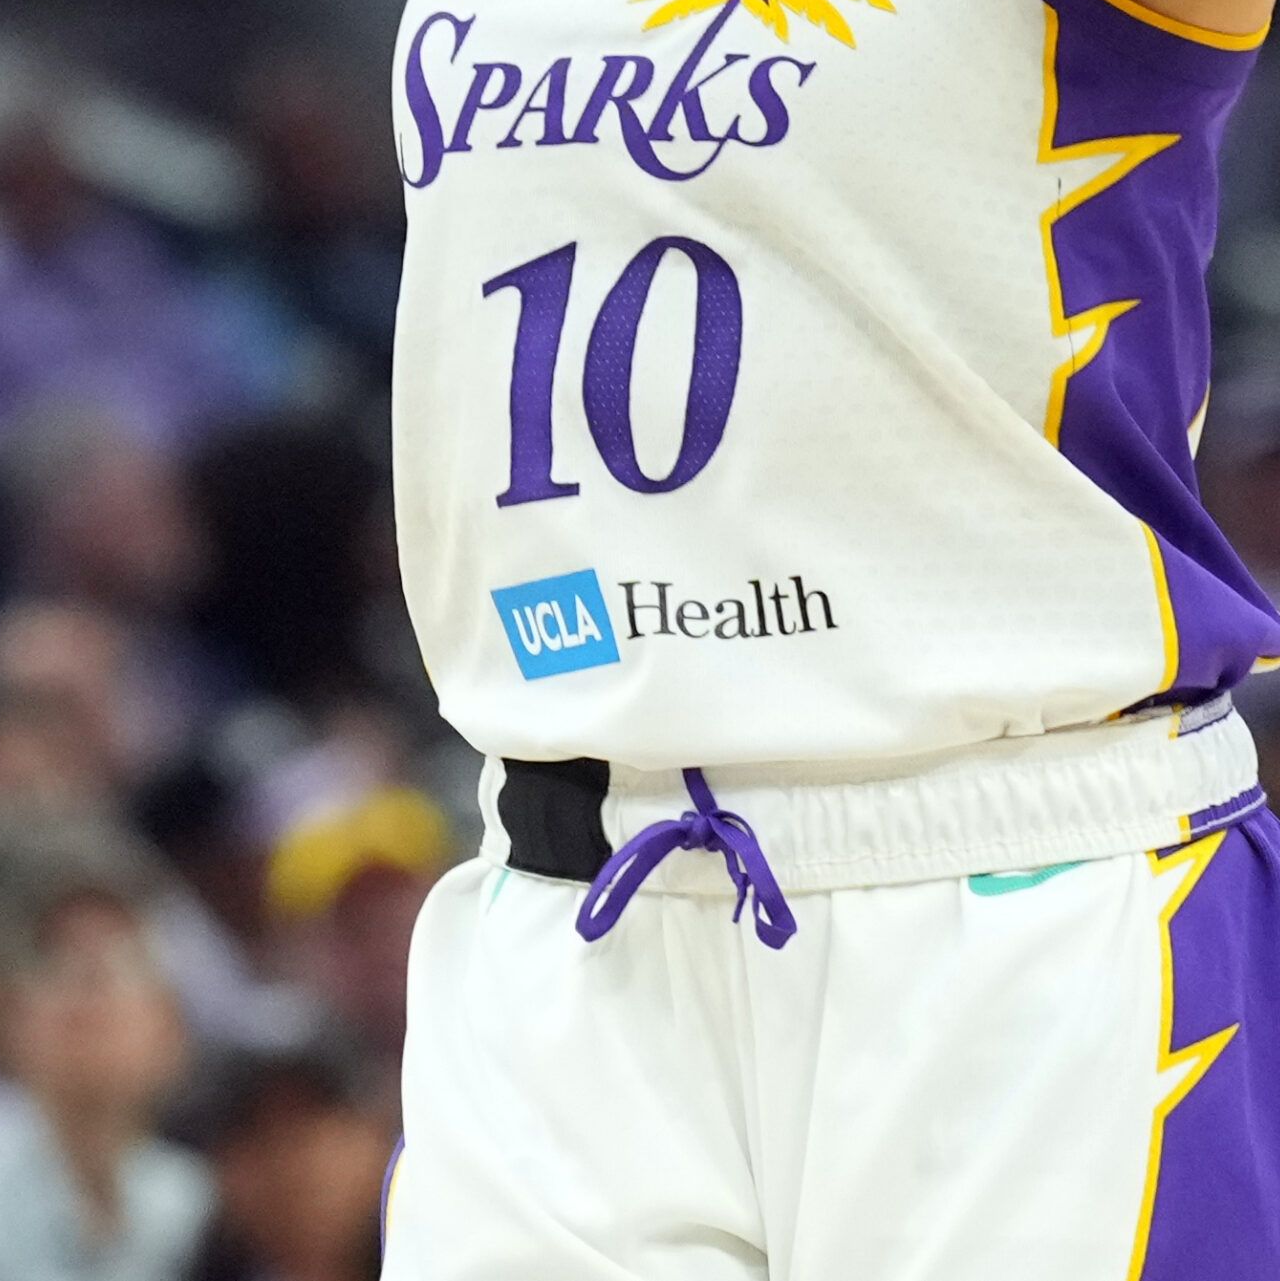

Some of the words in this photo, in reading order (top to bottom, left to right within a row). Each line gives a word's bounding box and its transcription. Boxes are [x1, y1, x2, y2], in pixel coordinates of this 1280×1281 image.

[482, 235, 744, 508] 10
[511, 594, 602, 656] UCLA
[617, 575, 839, 640] Health
